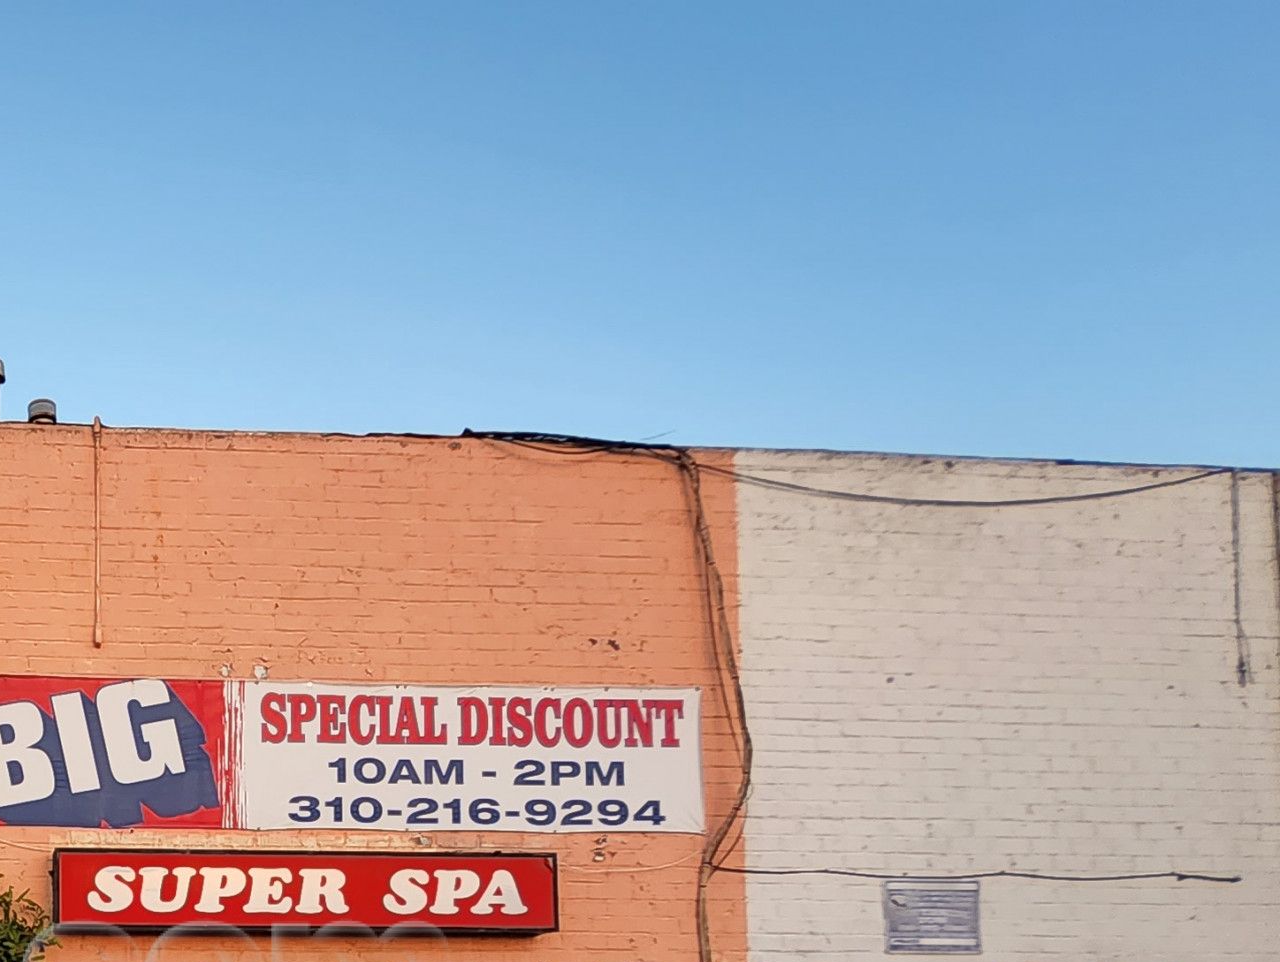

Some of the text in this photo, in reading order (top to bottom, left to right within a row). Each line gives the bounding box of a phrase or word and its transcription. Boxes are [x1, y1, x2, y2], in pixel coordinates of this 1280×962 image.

[261, 692, 684, 748] SPECIAL DISCOUNT
[328, 757, 464, 785] 10AM
[513, 759, 625, 787] 2PM
[287, 796, 666, 826] 310-216-9294
[87, 866, 528, 915] SUPER SPA
